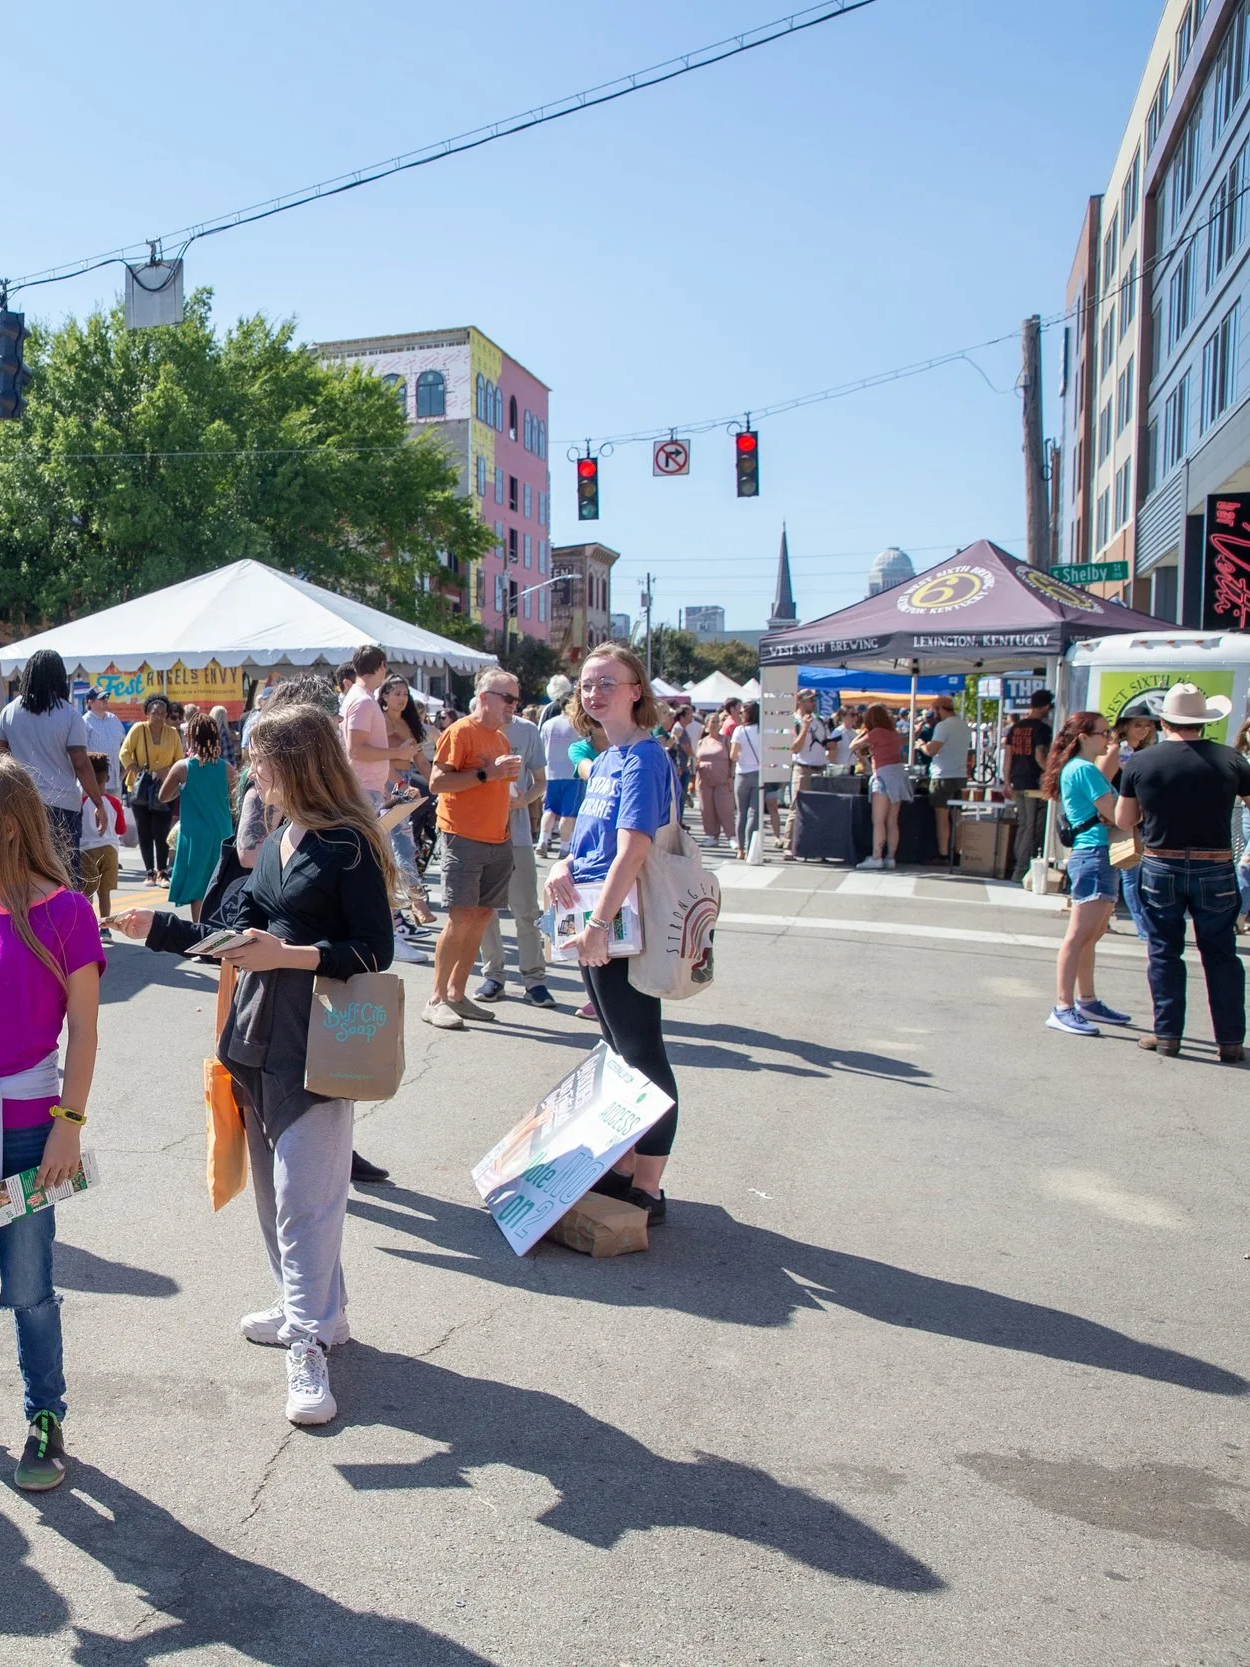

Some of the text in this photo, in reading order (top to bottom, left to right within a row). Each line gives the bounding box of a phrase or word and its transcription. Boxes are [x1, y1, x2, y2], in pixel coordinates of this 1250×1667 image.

[1062, 567, 1107, 583] Shelby
[769, 638, 878, 656] WEST SIXTH BREWING
[982, 634, 1050, 647] KENTUCKY
[97, 673, 145, 697] Fest
[204, 667, 238, 684] ENVY
[1130, 674, 1170, 693] SIXTH
[323, 1001, 387, 1028] Buff City
[335, 1022, 377, 1043] Soap
[598, 1101, 641, 1136] ACCESS
[543, 1152, 605, 1204] NO
[498, 1194, 554, 1239] on 2
